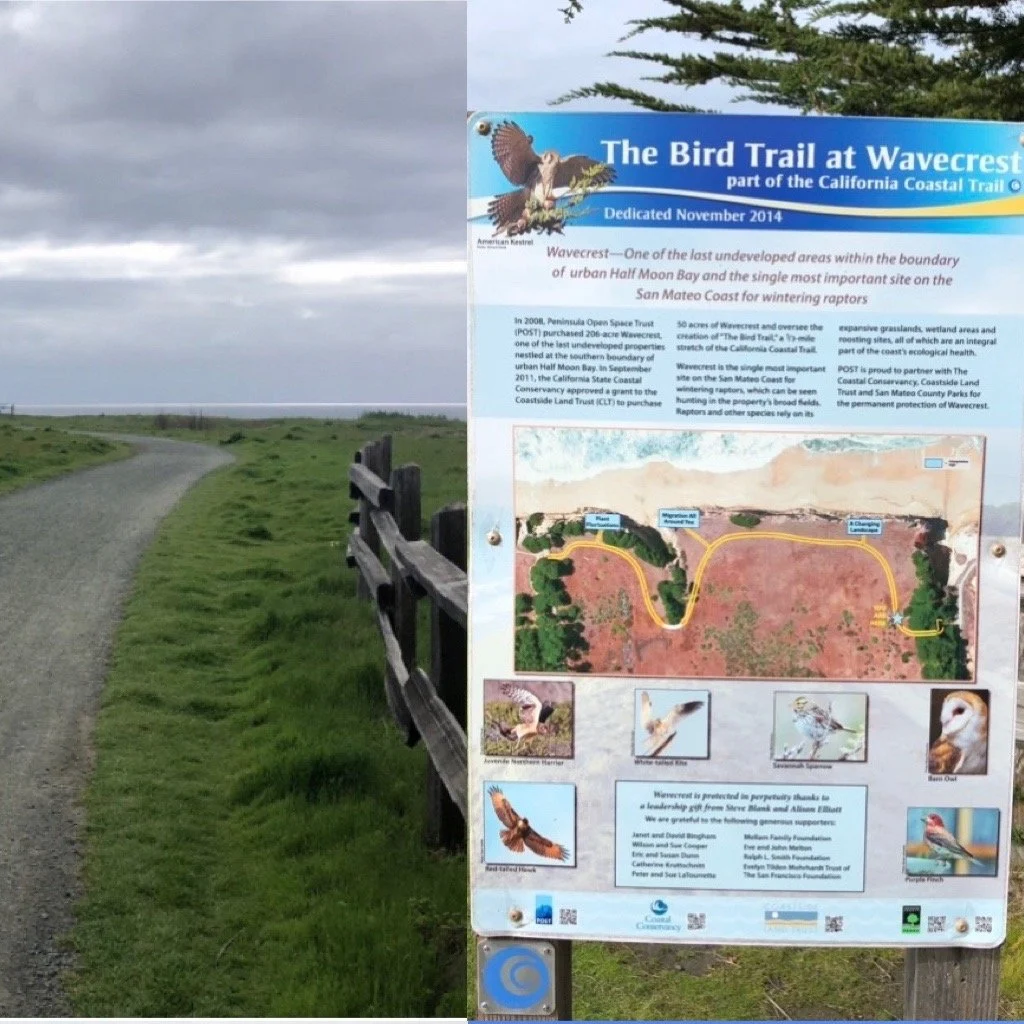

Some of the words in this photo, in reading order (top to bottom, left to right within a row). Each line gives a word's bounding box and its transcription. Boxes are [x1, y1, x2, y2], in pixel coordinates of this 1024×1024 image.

[600, 139, 658, 164] The
[670, 141, 734, 166] Bird
[745, 142, 815, 168] Trail
[827, 146, 856, 169] at
[866, 145, 1024, 174] Wavecrest
[727, 175, 759, 189] part
[765, 174, 783, 187] of
[788, 174, 813, 188] the
[819, 175, 898, 190] California
[904, 177, 962, 192] Coastal
[968, 179, 1004, 192] Trail
[604, 207, 672, 220] Dedicated
[676, 209, 745, 221] November
[749, 211, 783, 222] 2014
[653, 249, 666, 261] of
[668, 249, 687, 261] the
[690, 249, 712, 261] last
[715, 250, 795, 266] undeveloped
[798, 254, 831, 263] areas
[835, 252, 873, 264] within
[877, 253, 896, 265] the
[900, 253, 959, 269] boundary
[552, 266, 565, 278] of
[571, 267, 606, 279] urban
[610, 267, 635, 280] Half
[638, 268, 673, 280] Moon
[677, 269, 699, 284] Bay
[702, 269, 726, 281] and
[729, 270, 749, 282] the
[752, 270, 788, 286] single
[791, 271, 821, 283] most
[824, 272, 887, 288] important
[890, 273, 910, 285] site
[914, 276, 929, 285] on
[933, 274, 952, 286] the
[636, 288, 659, 300] San
[662, 289, 701, 301] Mateo
[704, 289, 739, 302] Coast
[741, 290, 758, 302] for
[763, 291, 820, 307] wintering
[824, 292, 868, 307] raptors
[515, 317, 522, 325] In
[524, 317, 545, 326] 2008,
[548, 318, 584, 326] Peninsula
[586, 319, 608, 328] Open
[610, 319, 633, 328] Space
[635, 319, 654, 327] Trust
[515, 329, 541, 338] (POST)
[543, 330, 583, 339] purchased
[586, 330, 619, 338] 206-acre
[621, 331, 662, 340] Wavecrest,
[839, 324, 878, 333] expansive
[880, 325, 923, 334] grasslands,
[926, 325, 956, 333] wetland
[542, 340, 554, 348] the
[572, 341, 623, 351] undeveloped
[625, 342, 665, 352] properties
[839, 335, 871, 345] roosting
[874, 336, 893, 344] sites,
[906, 336, 914, 344] of
[916, 336, 939, 344] which
[966, 337, 996, 346] integral
[515, 351, 543, 359] nestled
[570, 352, 604, 360] southern
[607, 353, 644, 363] boundary
[515, 362, 538, 370] urban
[558, 363, 580, 371] Moon
[582, 364, 598, 373] Bay.
[609, 364, 652, 374] September
[515, 374, 536, 382] 2011,
[538, 374, 550, 382] the
[553, 375, 589, 383] California
[592, 375, 611, 383] State
[613, 376, 642, 384] Coastal
[516, 385, 564, 395] Conservancy
[567, 386, 603, 396] approved
[612, 387, 632, 397] grant
[516, 396, 552, 404] Coastside
[554, 397, 573, 405] Land
[596, 398, 615, 407] (CLT)
[627, 399, 662, 408] purchase
[806, 763, 832, 771] Sparrow
[671, 816, 699, 825] grateful
[724, 817, 757, 826] following
[759, 819, 793, 827] generous
[795, 818, 836, 828] supporters:
